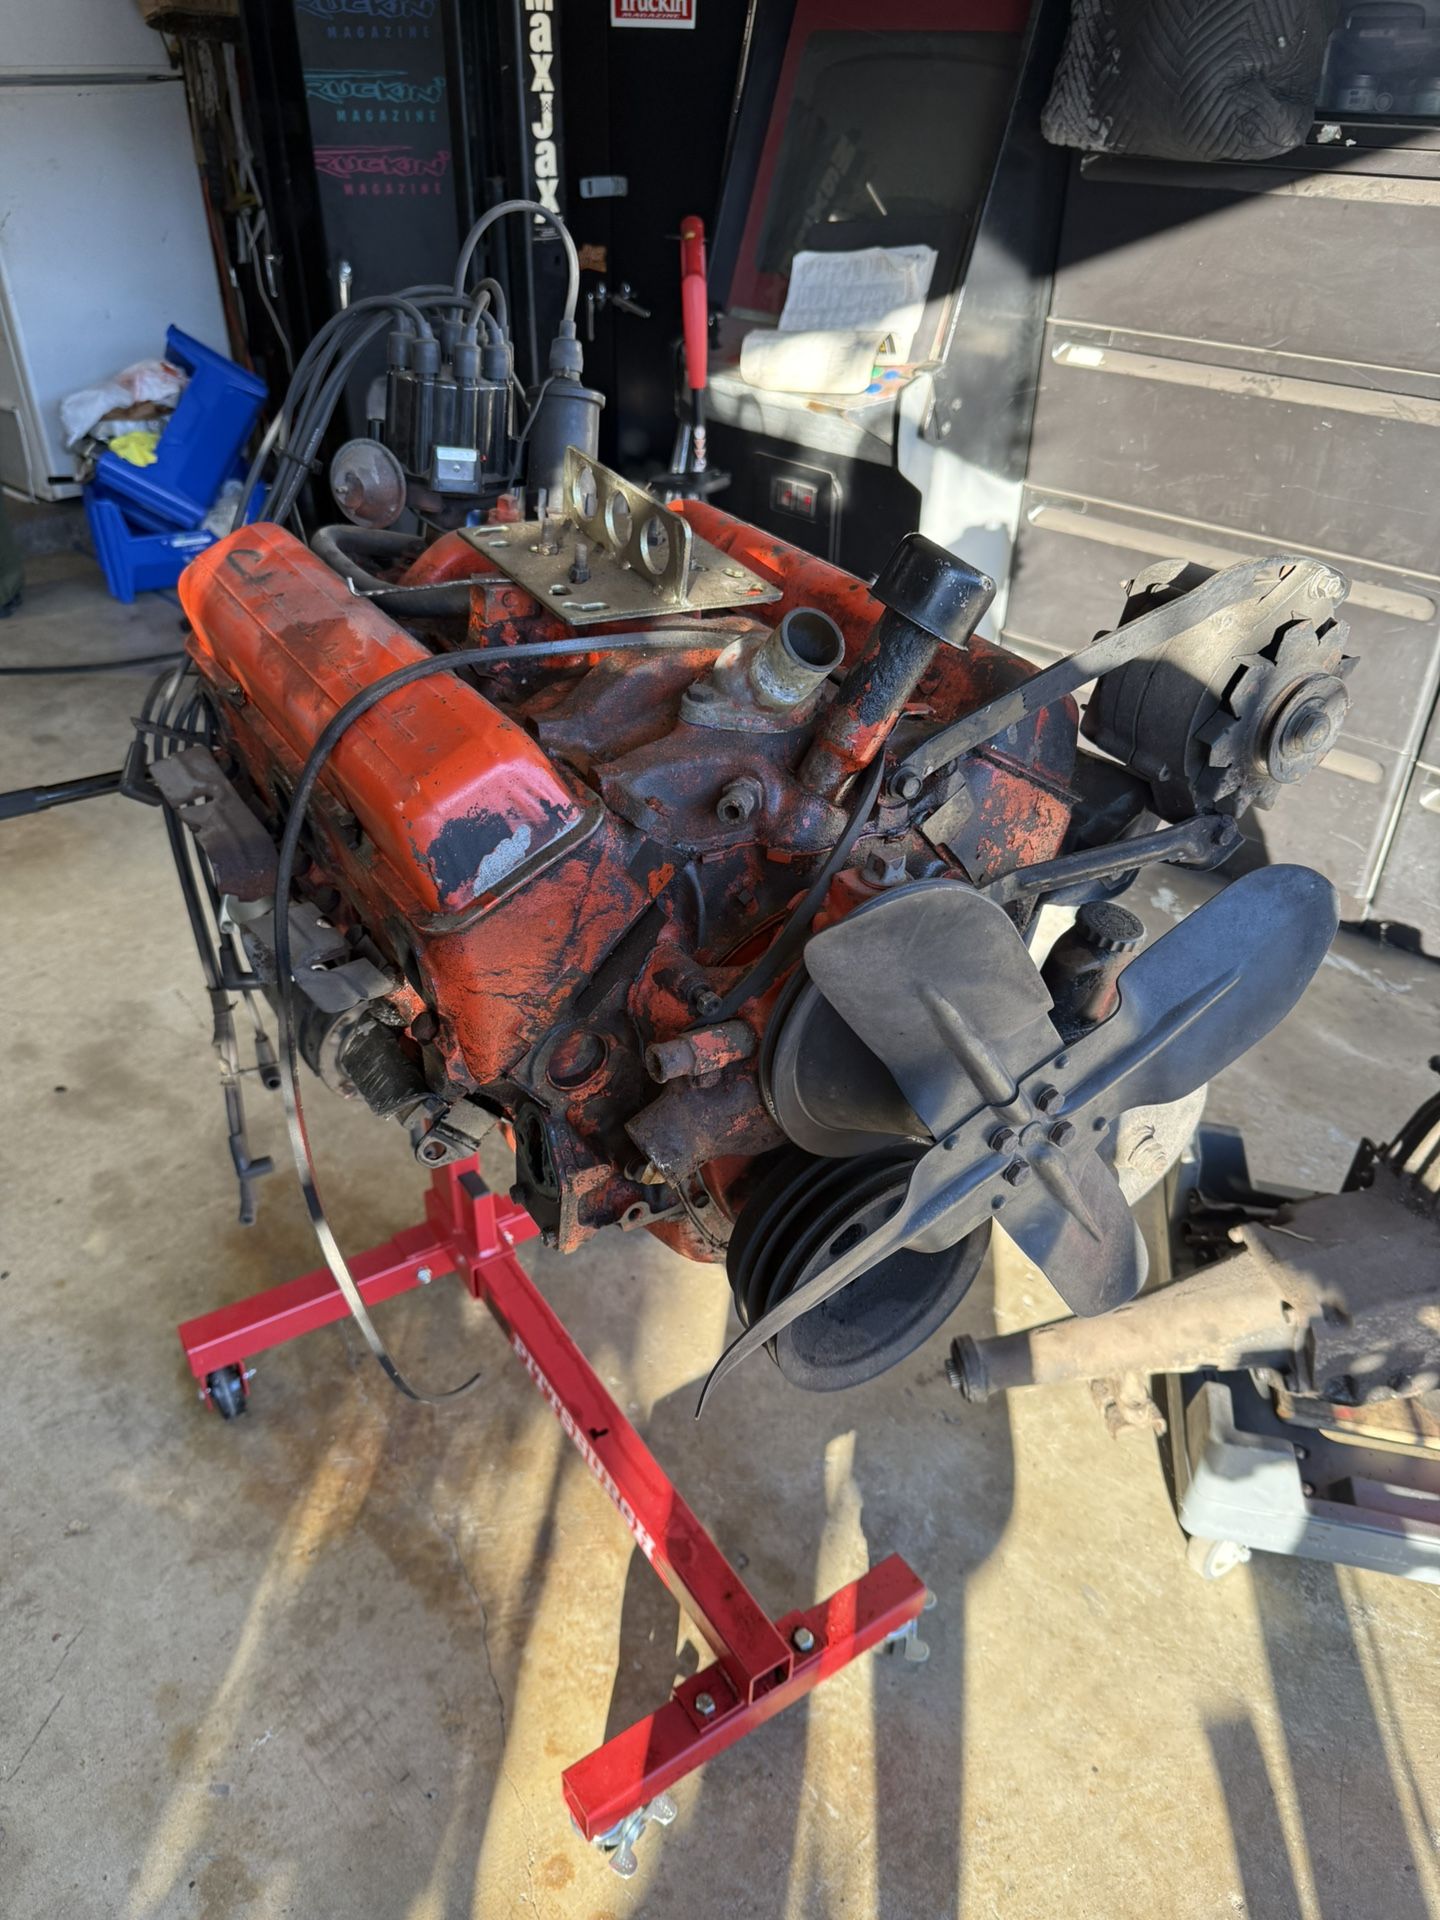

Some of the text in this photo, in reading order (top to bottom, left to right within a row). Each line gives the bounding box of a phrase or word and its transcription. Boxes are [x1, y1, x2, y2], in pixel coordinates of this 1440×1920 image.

[326, 25, 432, 39] MAGAZINE
[336, 109, 437, 123] MAGAZINE
[525, 0, 562, 224] axJax
[343, 182, 442, 196] MAGAZINE
